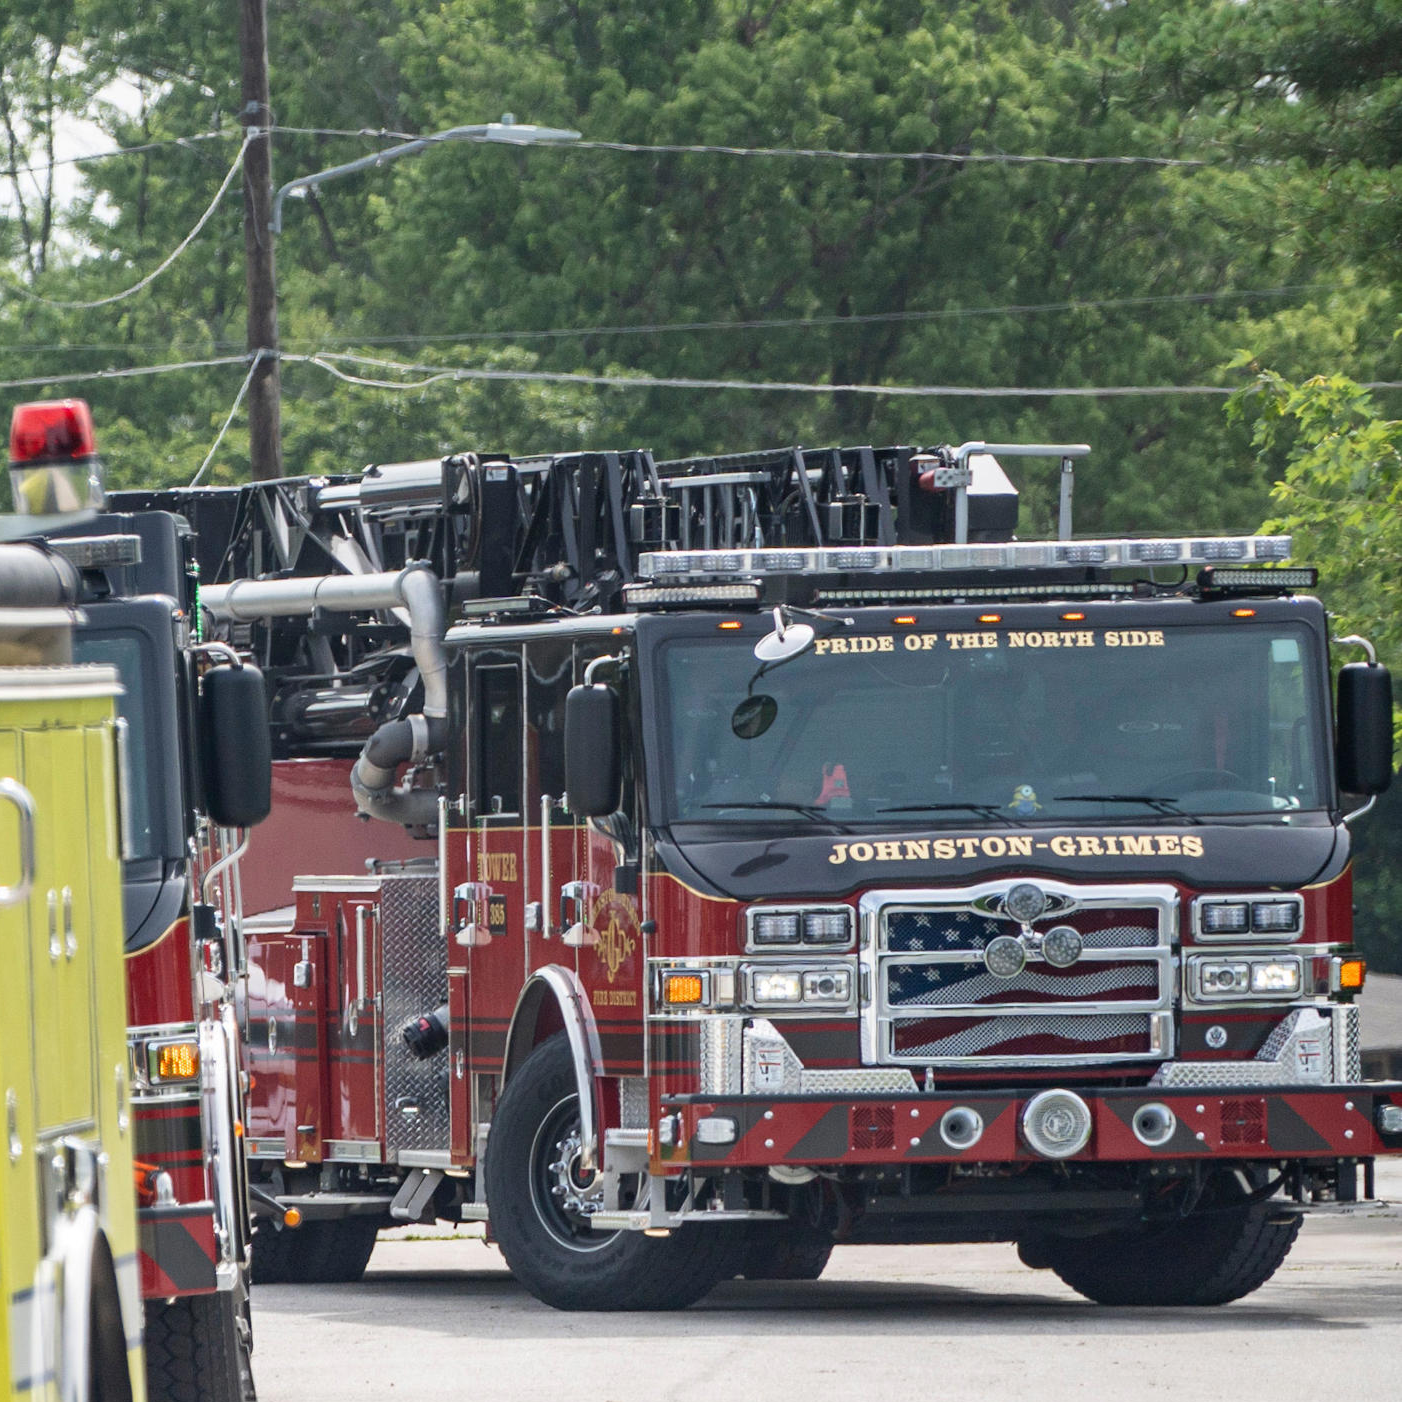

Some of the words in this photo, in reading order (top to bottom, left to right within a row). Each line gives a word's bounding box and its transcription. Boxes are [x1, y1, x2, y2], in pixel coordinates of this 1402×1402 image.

[814, 635, 895, 655] PRIDE
[904, 633, 938, 650] OF
[946, 632, 998, 650] THE
[1008, 630, 1095, 648] NORTH
[1104, 629, 1165, 647] SIDE
[828, 835, 1204, 865] JOHNSTON-GRIMES
